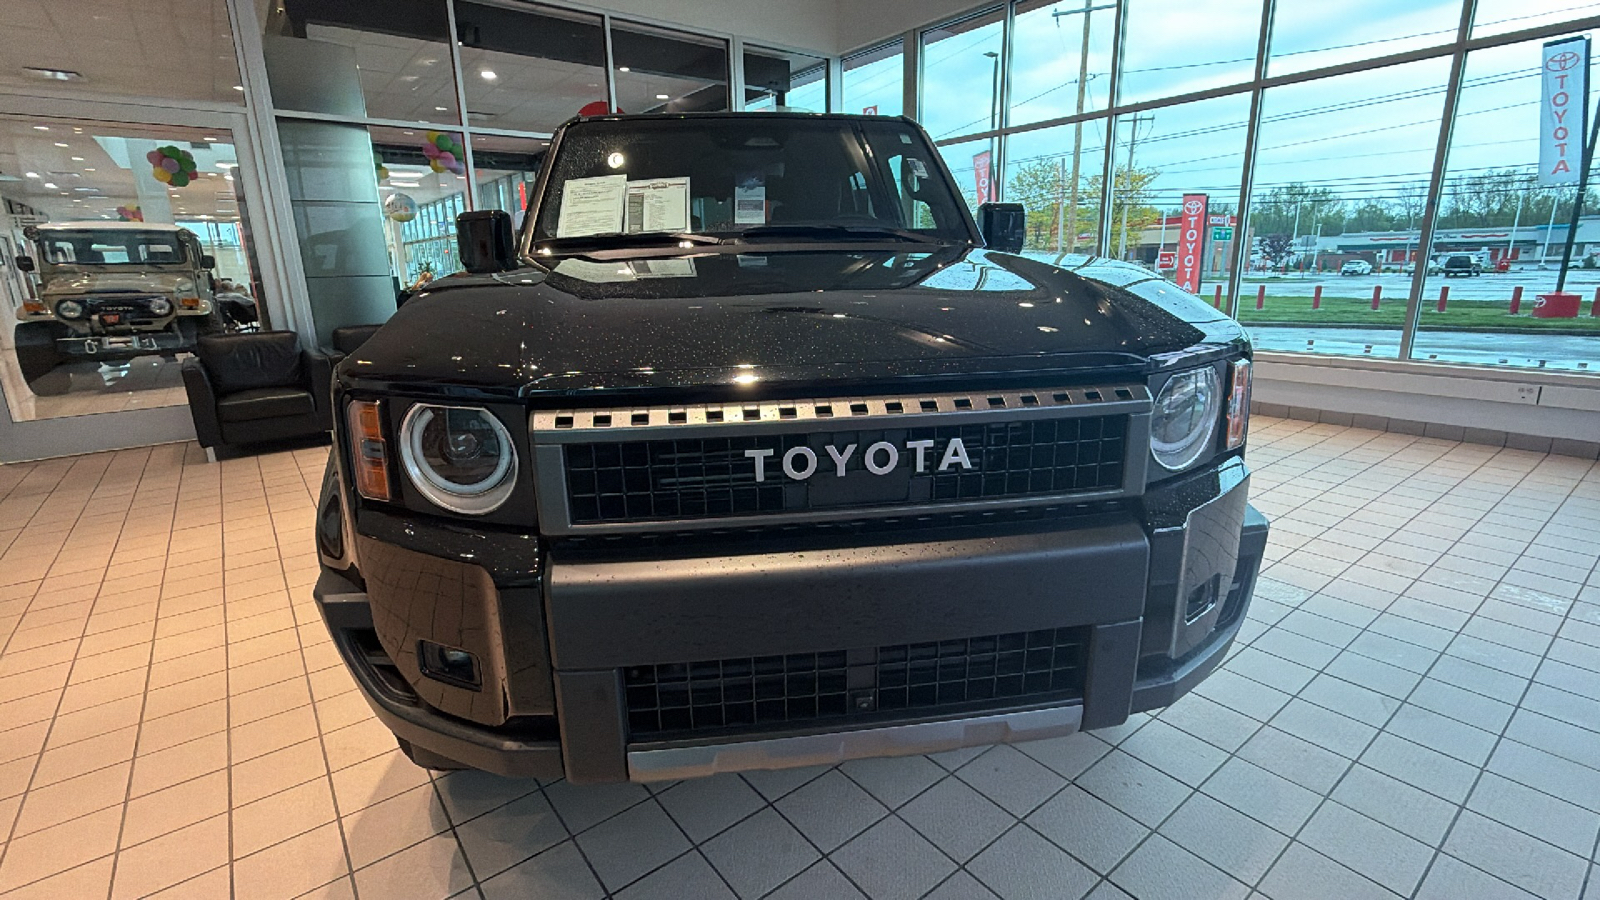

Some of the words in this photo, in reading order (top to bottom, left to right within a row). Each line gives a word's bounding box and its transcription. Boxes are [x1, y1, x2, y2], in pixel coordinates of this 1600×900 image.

[1551, 75, 1571, 175] TOYOTA
[1182, 216, 1198, 292] TOYOTA
[744, 438, 972, 482] TOYOTA
